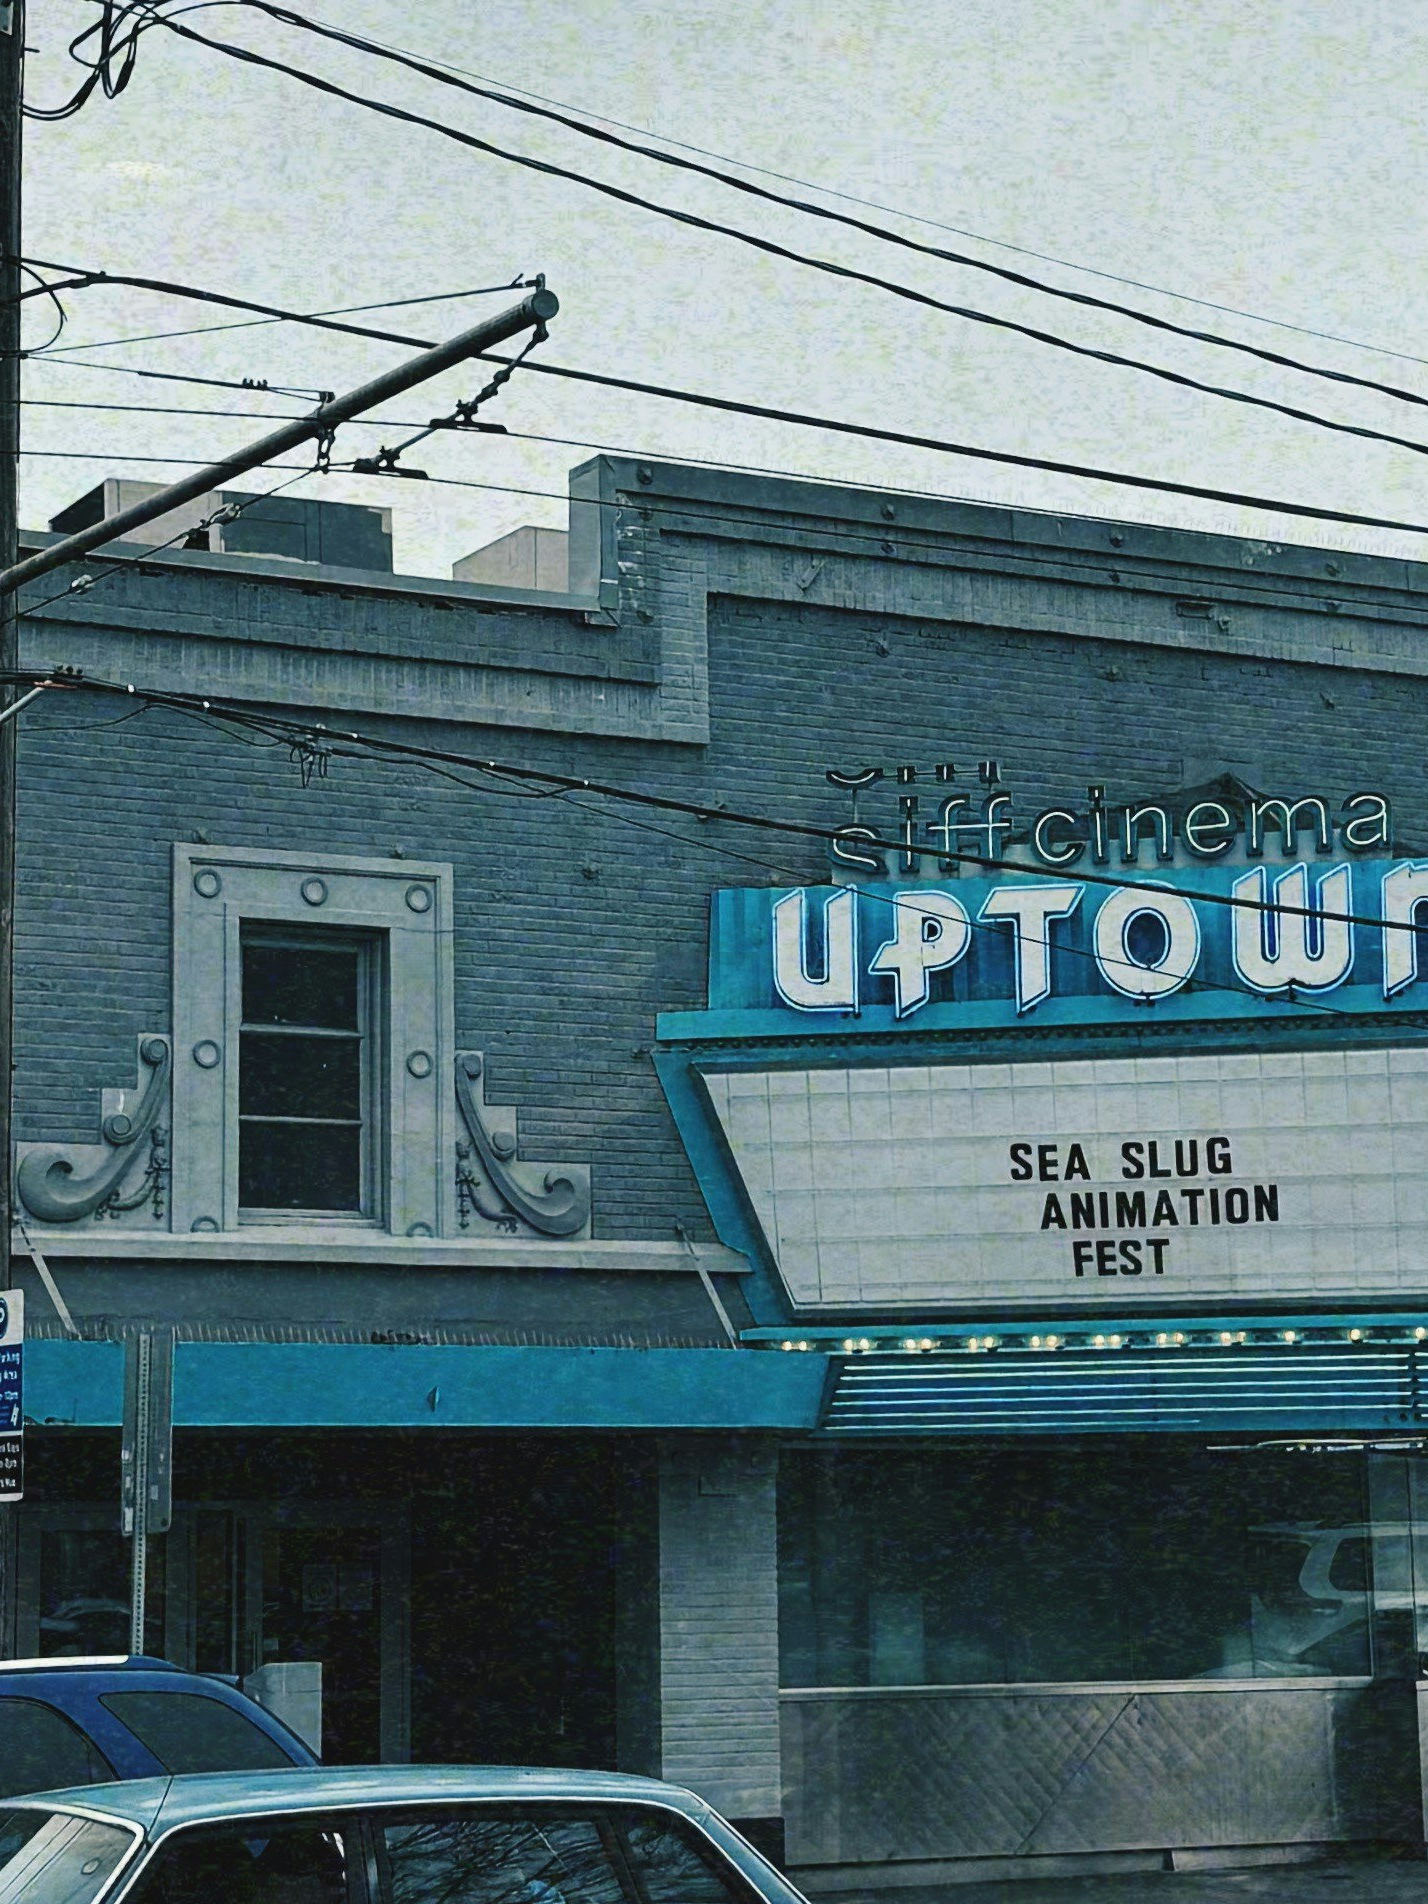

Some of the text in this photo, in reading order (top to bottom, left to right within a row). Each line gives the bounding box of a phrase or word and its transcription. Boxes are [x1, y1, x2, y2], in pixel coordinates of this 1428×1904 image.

[1032, 785, 1393, 868] cinema
[1010, 1137, 1232, 1181] SEA SLUG
[1041, 1184, 1279, 1229] ANIMATION
[1072, 1238, 1170, 1277] FEST
